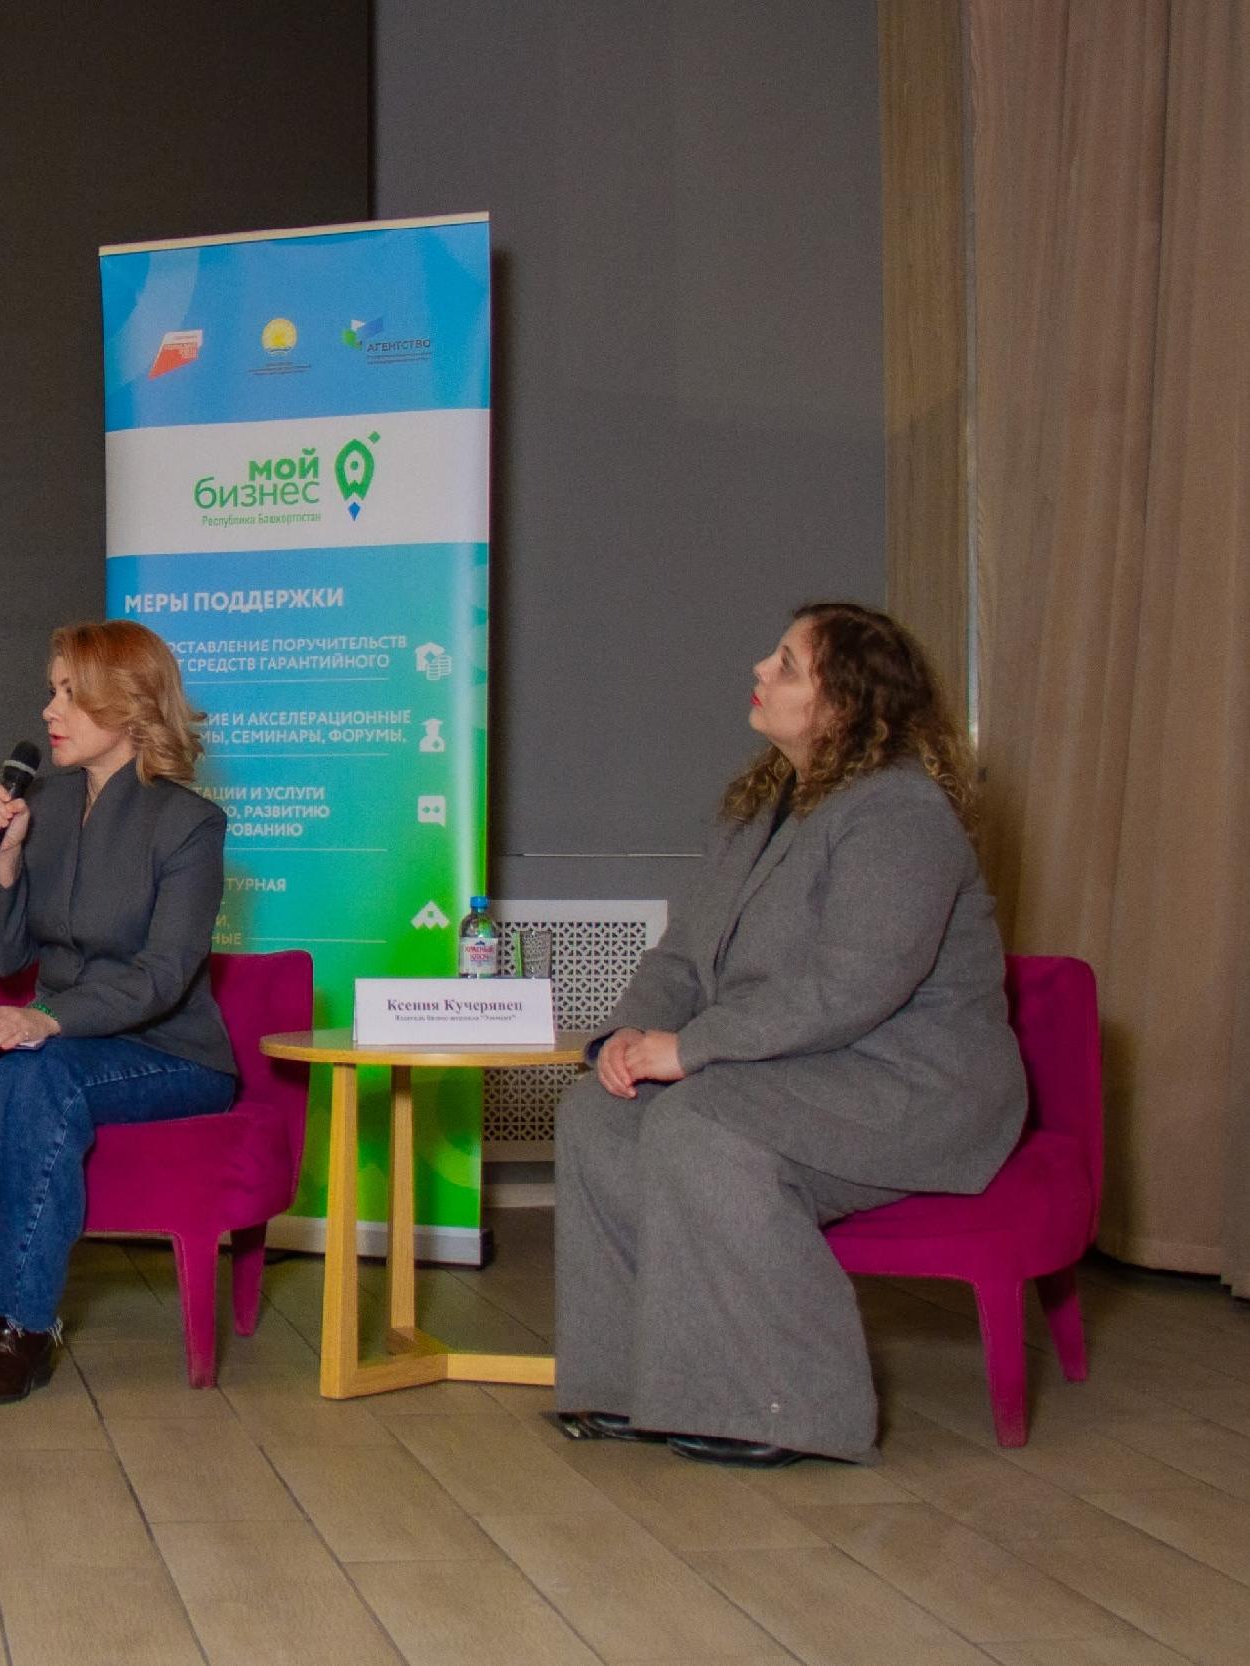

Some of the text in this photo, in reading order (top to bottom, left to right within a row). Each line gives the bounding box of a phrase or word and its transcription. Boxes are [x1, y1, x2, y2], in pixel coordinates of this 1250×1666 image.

[366, 339, 431, 352] АГЕНТСТВО
[248, 447, 319, 481] мой
[194, 476, 320, 509] бизнес
[202, 513, 321, 528] Республика Башкортостан
[125, 587, 344, 613] МЕРЫ ПОДДЕРЖКИ
[168, 635, 408, 654] ОСТАВЛЕНИЕ ПОРУЧИТЕЛЬСТВ
[187, 657, 256, 673] СРЕДСТВ
[259, 653, 390, 671] ГАРАНТИЙНОГО
[232, 712, 244, 726] И
[249, 709, 412, 727] АКСЕЛЕРАЦИОННЫЕ
[200, 730, 229, 745] МЫ,
[231, 729, 326, 745] СЕМИНАРЫ,
[194, 786, 327, 801] ТАЦИИ И УСЛУГИ
[244, 805, 331, 818] РАЗВИТИЮ
[226, 878, 287, 892] ТУРНАЯ
[386, 998, 523, 1014] Ксения Кучерявец
